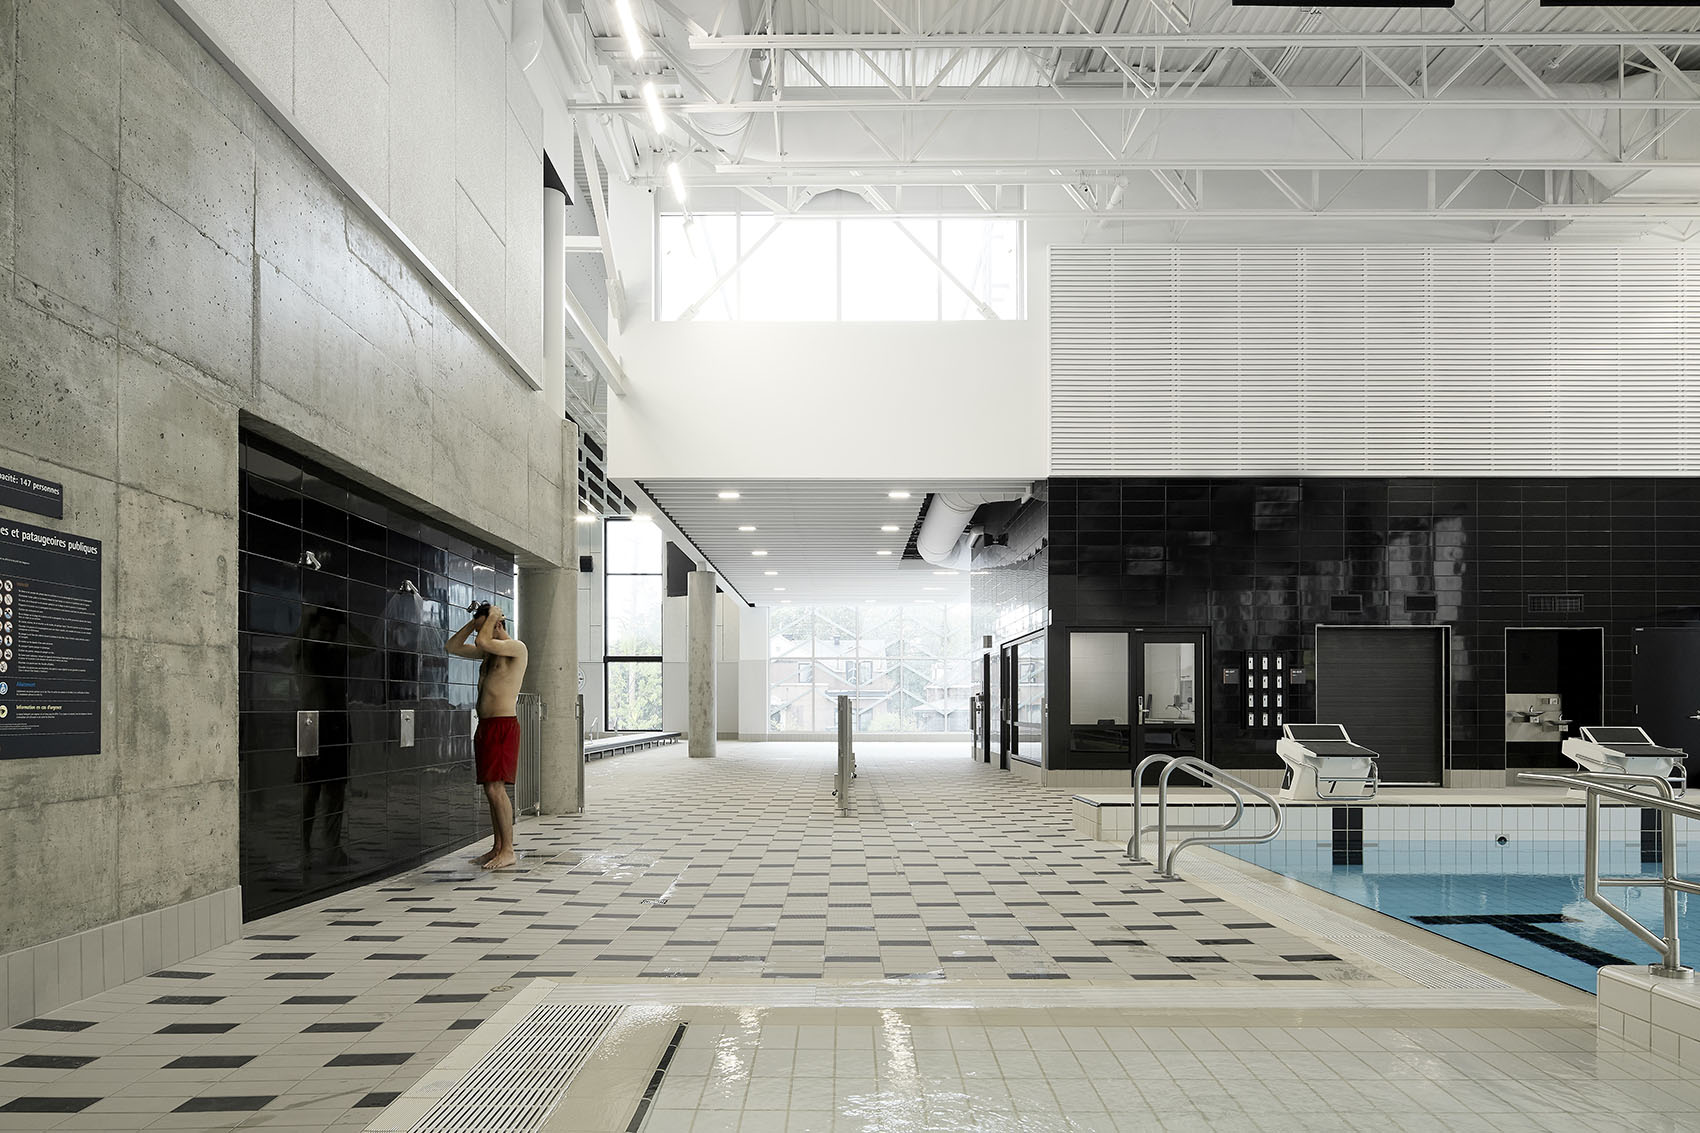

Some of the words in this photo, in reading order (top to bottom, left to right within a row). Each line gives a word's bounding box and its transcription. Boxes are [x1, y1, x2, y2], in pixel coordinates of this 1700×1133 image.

[20, 477, 31, 487] 147
[33, 482, 60, 495] personnes
[11, 528, 20, 538] et
[22, 531, 67, 547] pataugeoires
[68, 541, 98, 555] publiques
